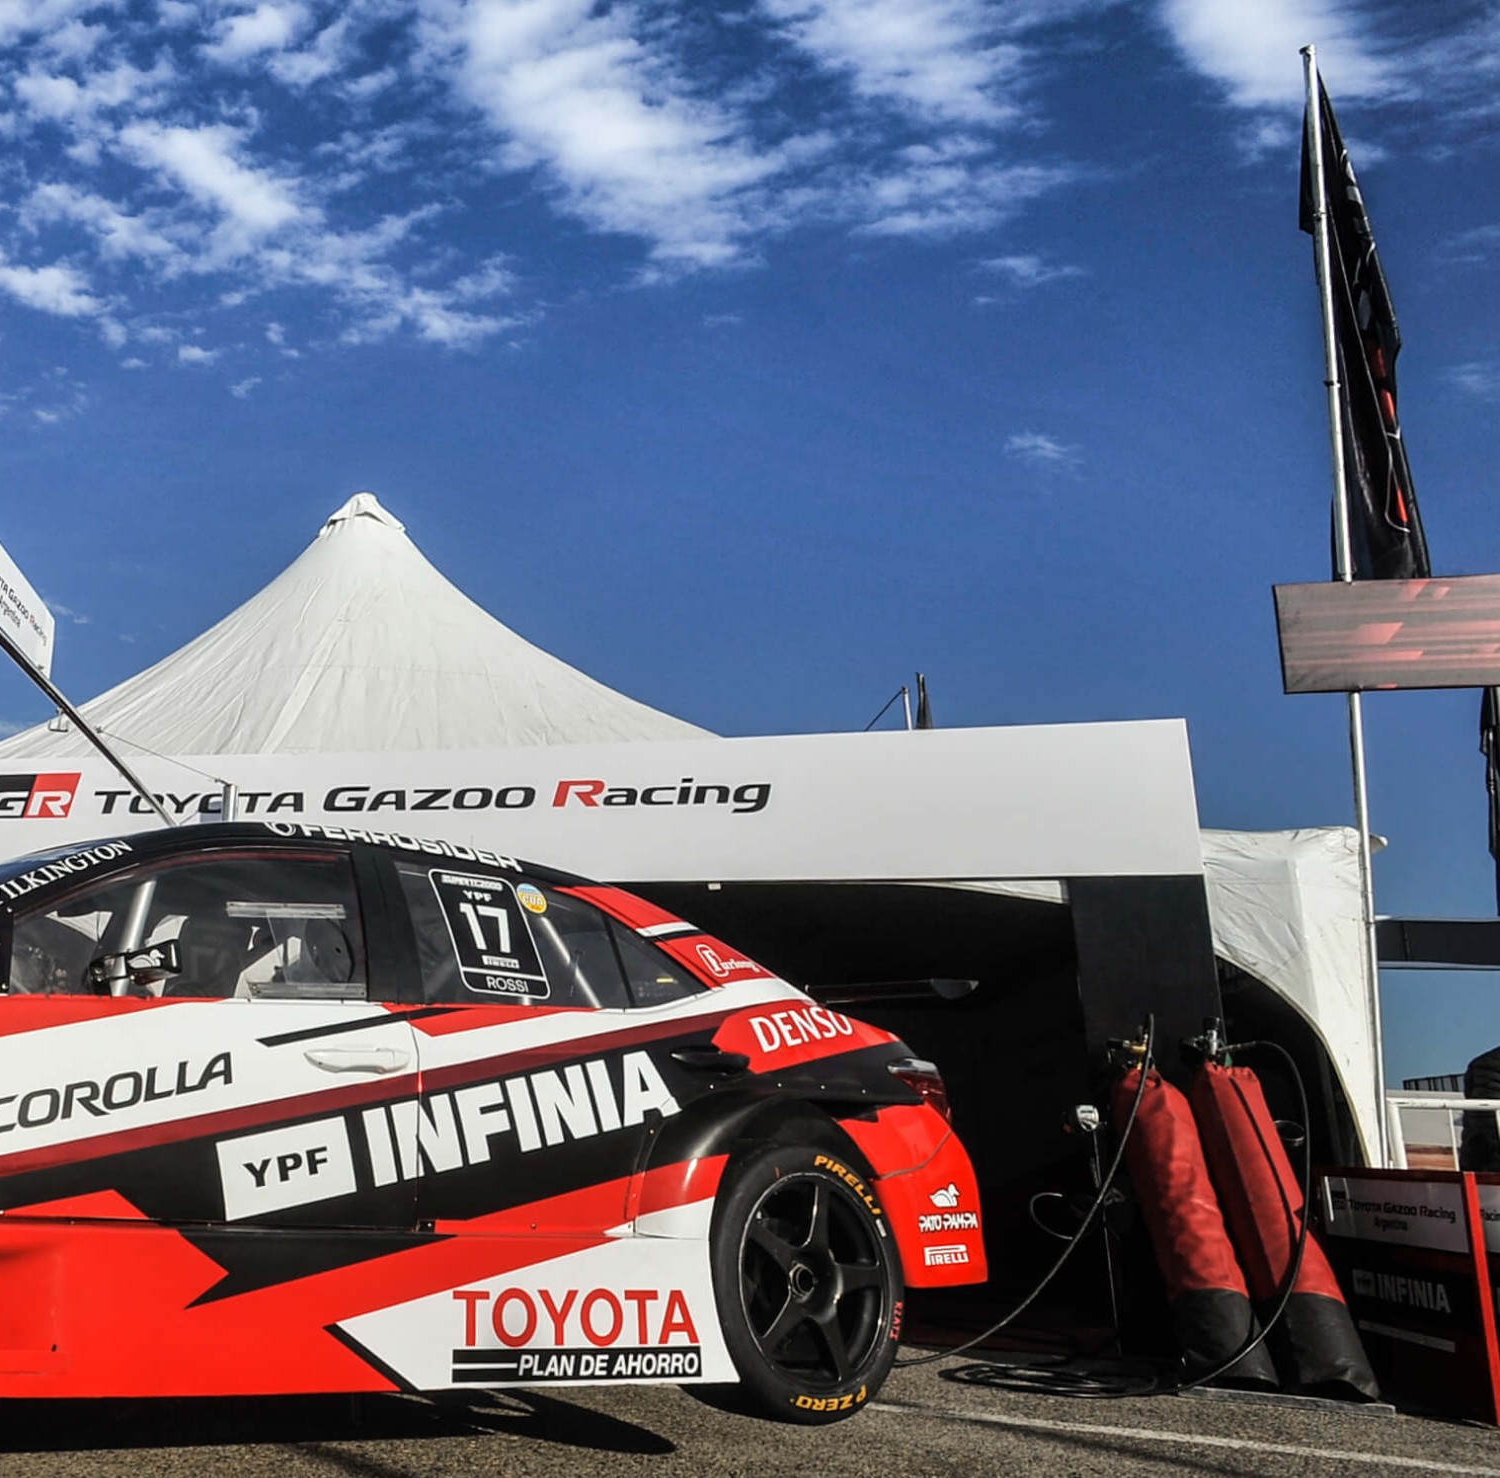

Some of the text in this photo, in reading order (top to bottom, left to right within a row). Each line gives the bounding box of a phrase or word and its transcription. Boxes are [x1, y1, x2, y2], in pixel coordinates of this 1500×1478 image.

[322, 785, 538, 813] GAZOO
[551, 777, 772, 815] Racing
[462, 889, 493, 903] YPF
[458, 901, 512, 954] 17
[485, 975, 529, 993] ROSSI
[748, 1006, 854, 1054] DENSO
[242, 1049, 683, 1189] YPF INFINIA
[814, 1154, 882, 1216] PIRELLI
[1383, 1202, 1418, 1217] GAZOO
[1419, 1206, 1456, 1224] Racing
[923, 1244, 969, 1267] PIRELLI
[1376, 1271, 1452, 1313] INFINIA
[452, 1287, 700, 1348] TOYOTA
[518, 1352, 700, 1377] PLAN DE AHORRO
[795, 1393, 854, 1412] ZERO
